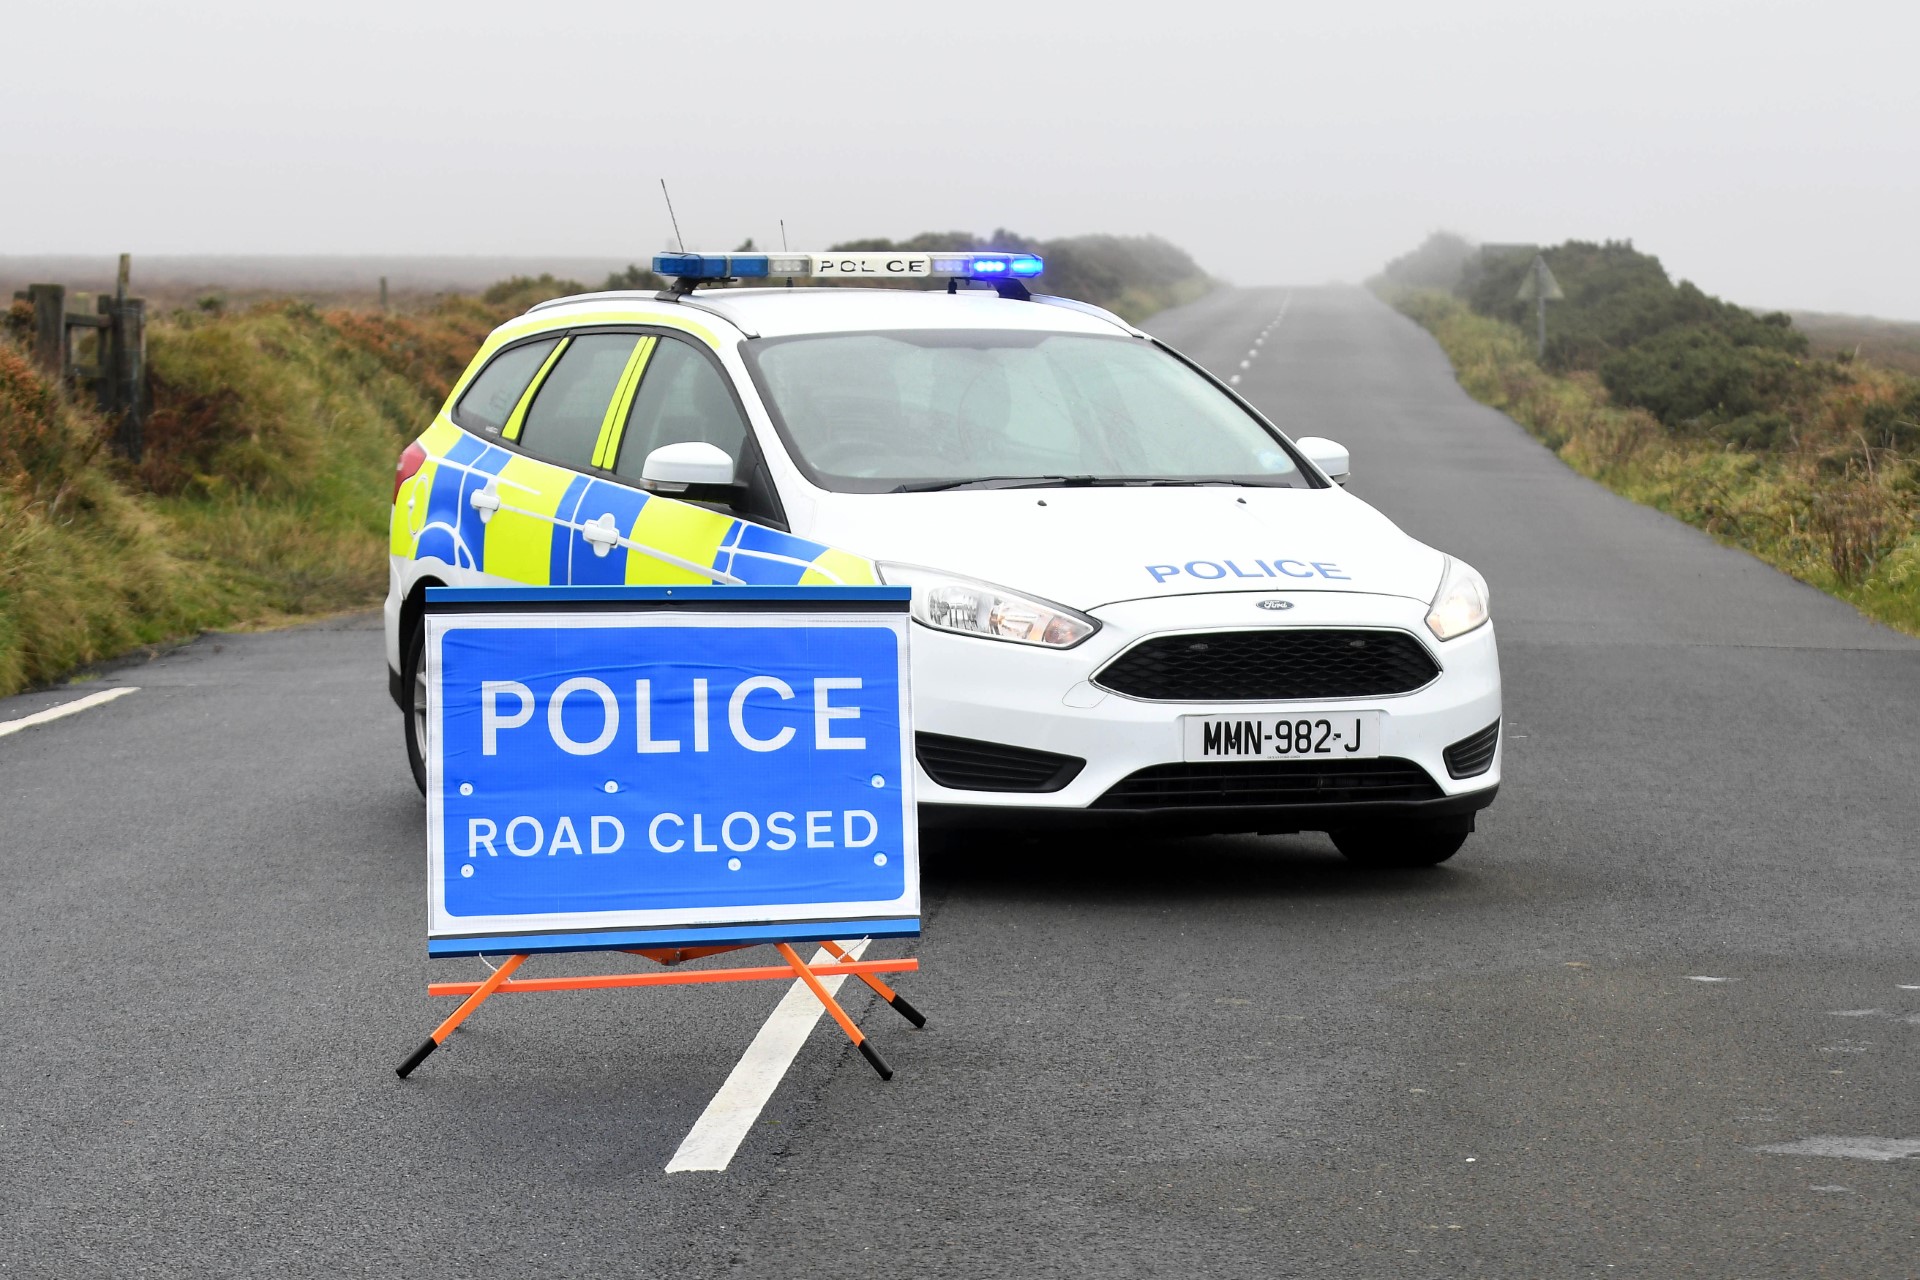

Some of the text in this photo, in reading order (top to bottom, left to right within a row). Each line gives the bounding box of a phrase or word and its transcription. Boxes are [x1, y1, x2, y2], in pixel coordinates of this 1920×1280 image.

[819, 260, 925, 272] POLCE
[1145, 559, 1352, 583] POLICE
[481, 676, 867, 756] POLICE
[1203, 718, 1362, 756] MMN-982-J
[468, 809, 879, 858] ROAD CLOSED
